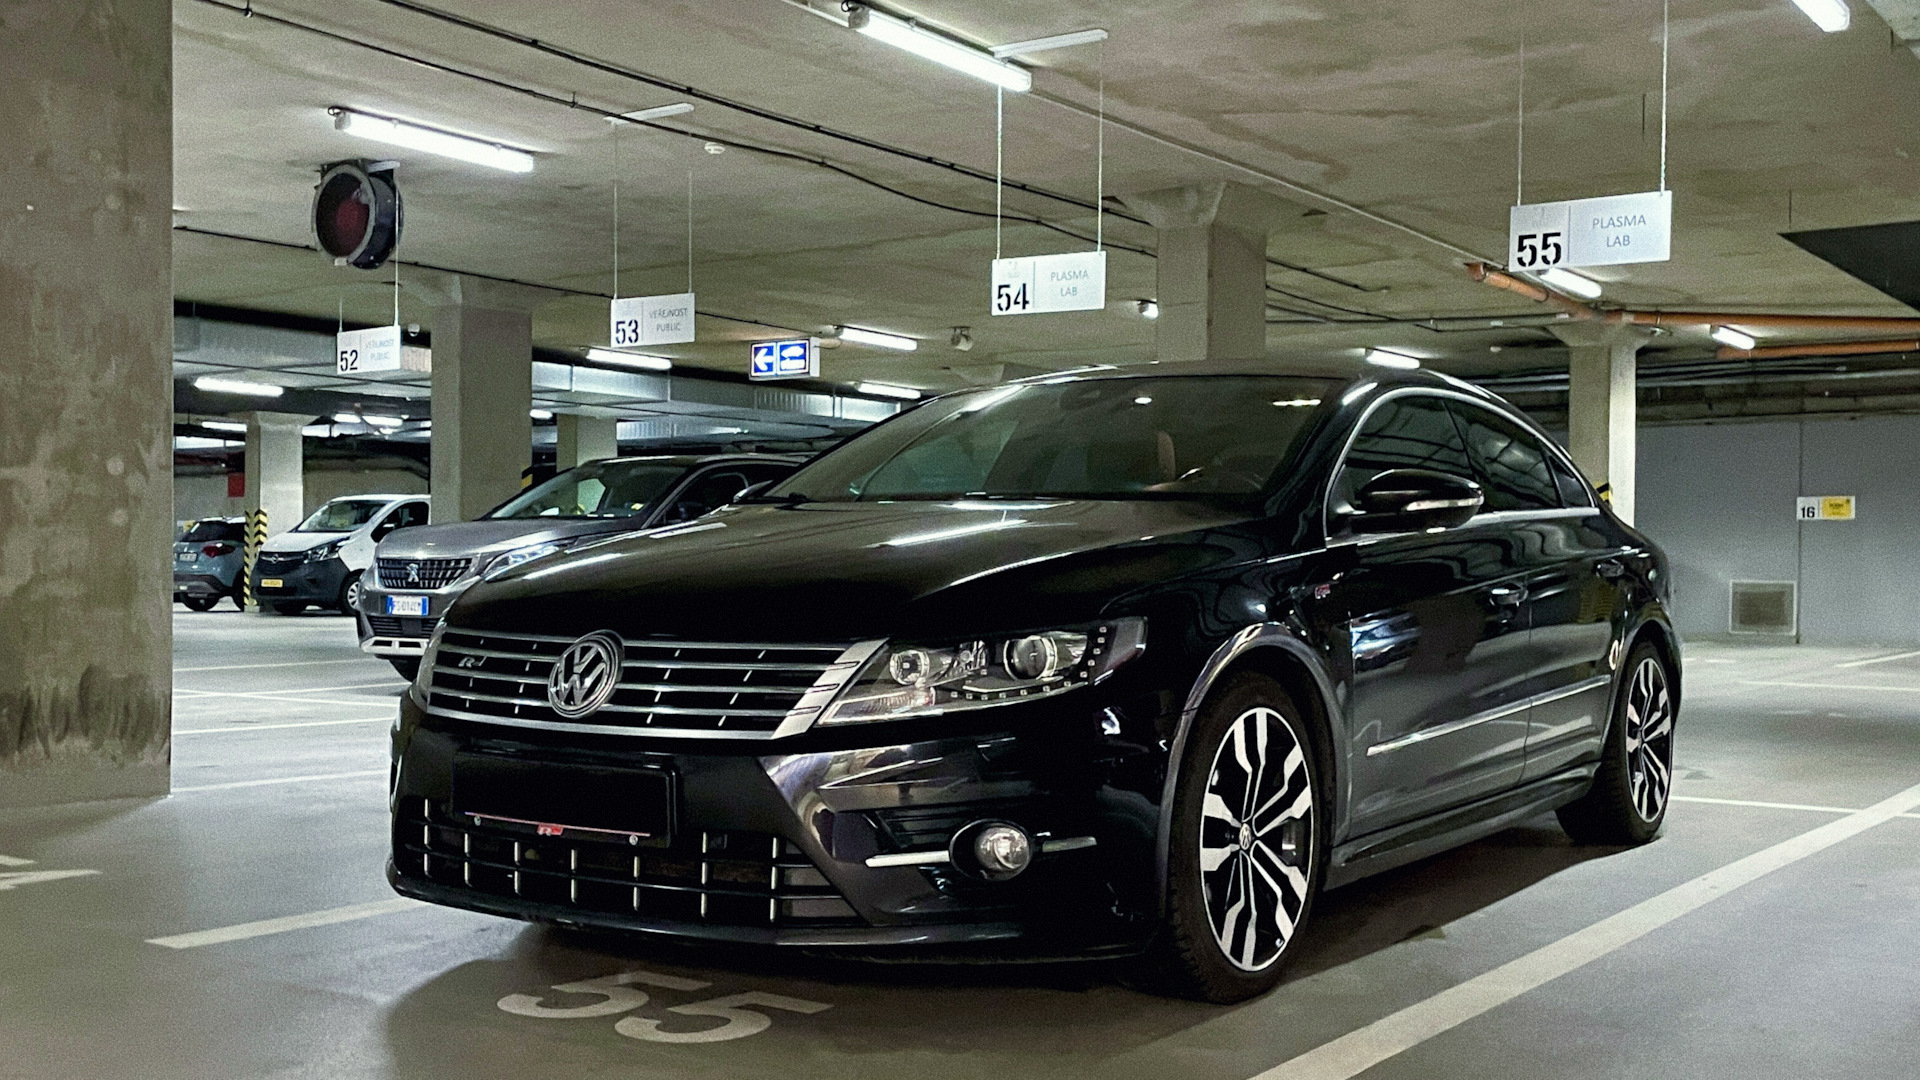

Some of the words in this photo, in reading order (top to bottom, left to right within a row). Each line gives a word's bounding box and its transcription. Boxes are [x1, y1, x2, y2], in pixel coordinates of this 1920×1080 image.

[1592, 214, 1647, 230] PLASMA
[1517, 232, 1562, 267] 55
[1606, 235, 1631, 248] LAB
[1050, 270, 1089, 282] PLASMA
[997, 283, 1030, 312] 54
[1060, 286, 1078, 297] LAB
[615, 319, 639, 345] 53
[656, 322, 681, 332] PUBLIC
[340, 349, 359, 372] 52
[1801, 506, 1815, 518] 16
[497, 970, 835, 1044] 55
